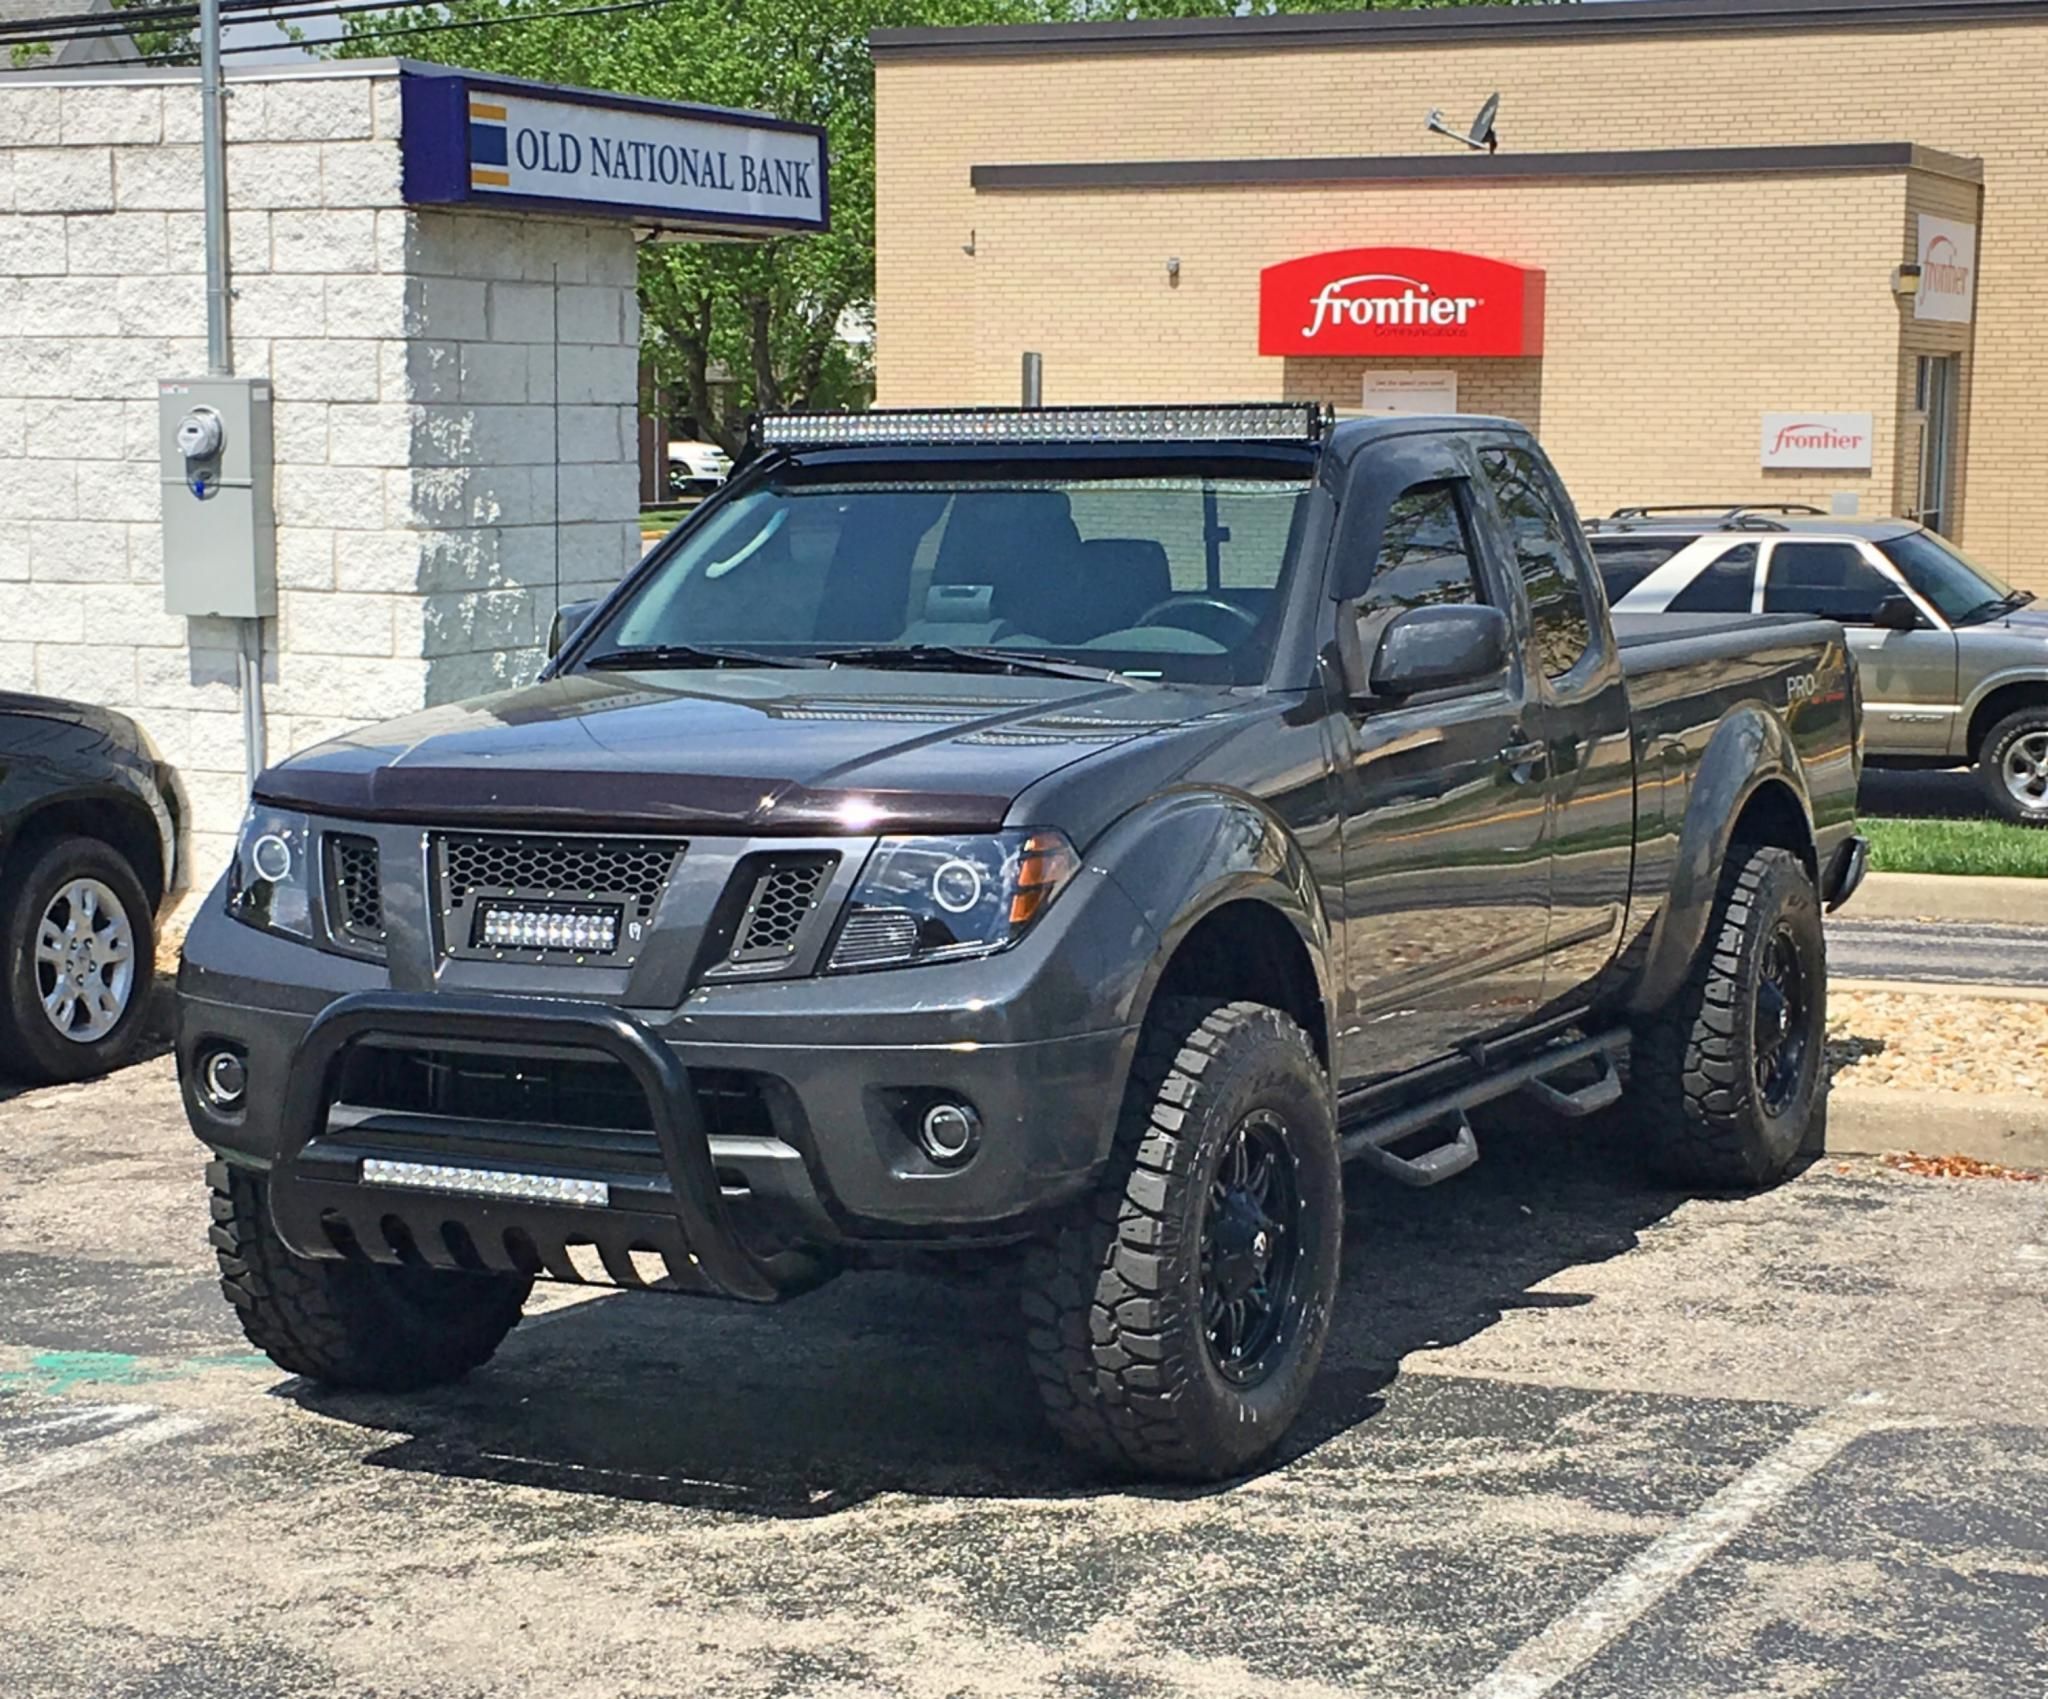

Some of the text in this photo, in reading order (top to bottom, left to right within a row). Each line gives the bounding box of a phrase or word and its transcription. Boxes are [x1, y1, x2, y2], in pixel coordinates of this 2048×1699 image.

[516, 128, 813, 199] OLD NATIONAL BANK
[1302, 274, 1478, 338] frontier
[1769, 423, 1863, 455] frontier
